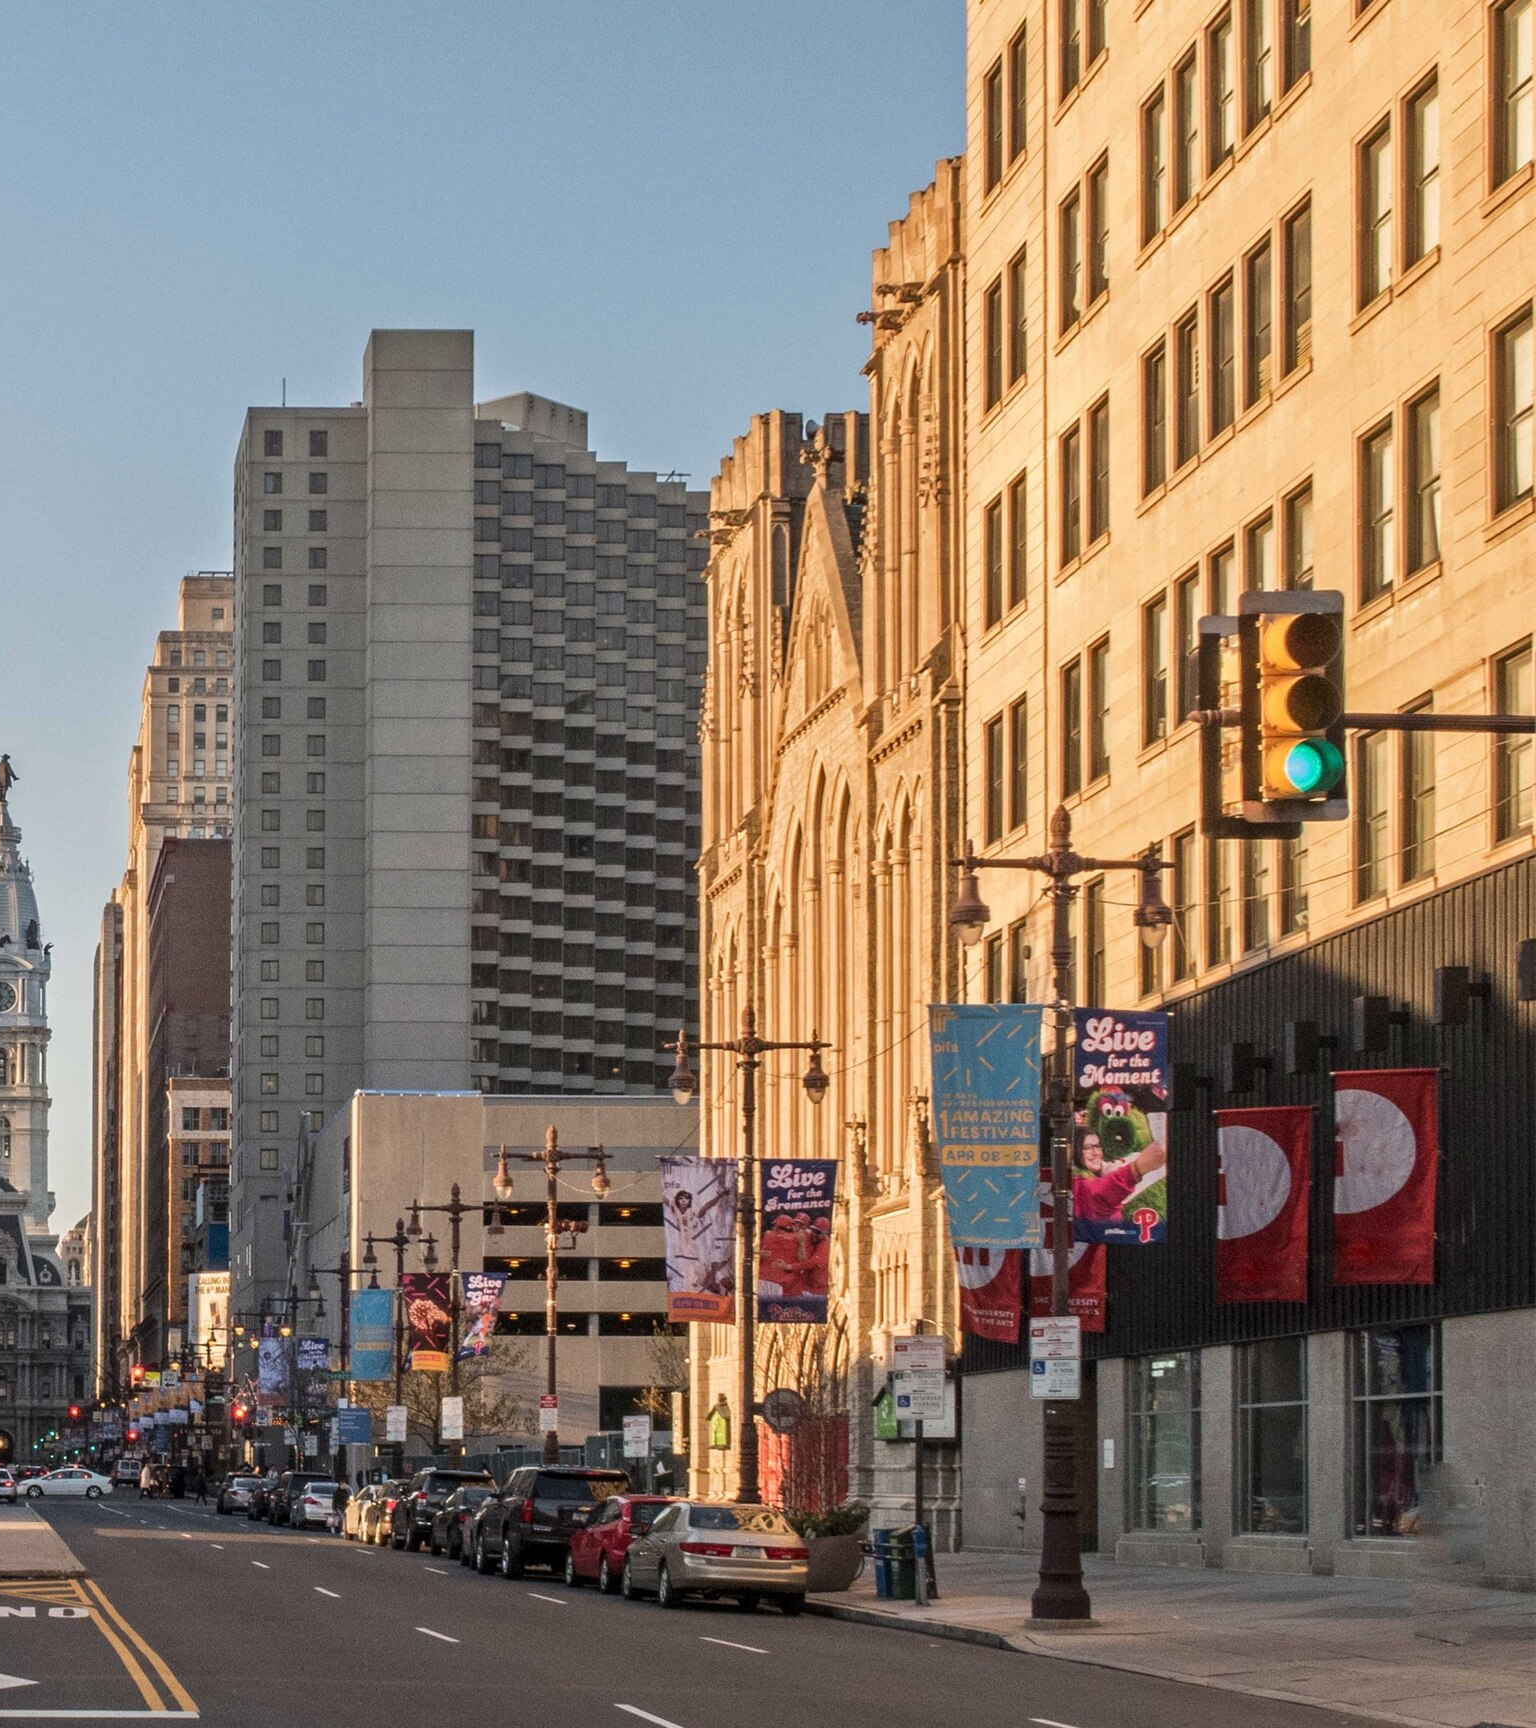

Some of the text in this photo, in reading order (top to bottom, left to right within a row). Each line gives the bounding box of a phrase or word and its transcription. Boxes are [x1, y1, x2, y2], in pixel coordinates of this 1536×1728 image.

[1081, 1016, 1155, 1052] Live
[1107, 1054, 1150, 1069] for the
[1079, 1064, 1161, 1088] Moment
[952, 1110, 1034, 1122] AMAZING
[947, 1150, 975, 1161] APR
[1013, 1150, 1032, 1161] 23
[766, 1163, 826, 1189] Live
[787, 1188, 823, 1200] for the
[764, 1196, 832, 1212] Bromance
[467, 1274, 502, 1289] Live
